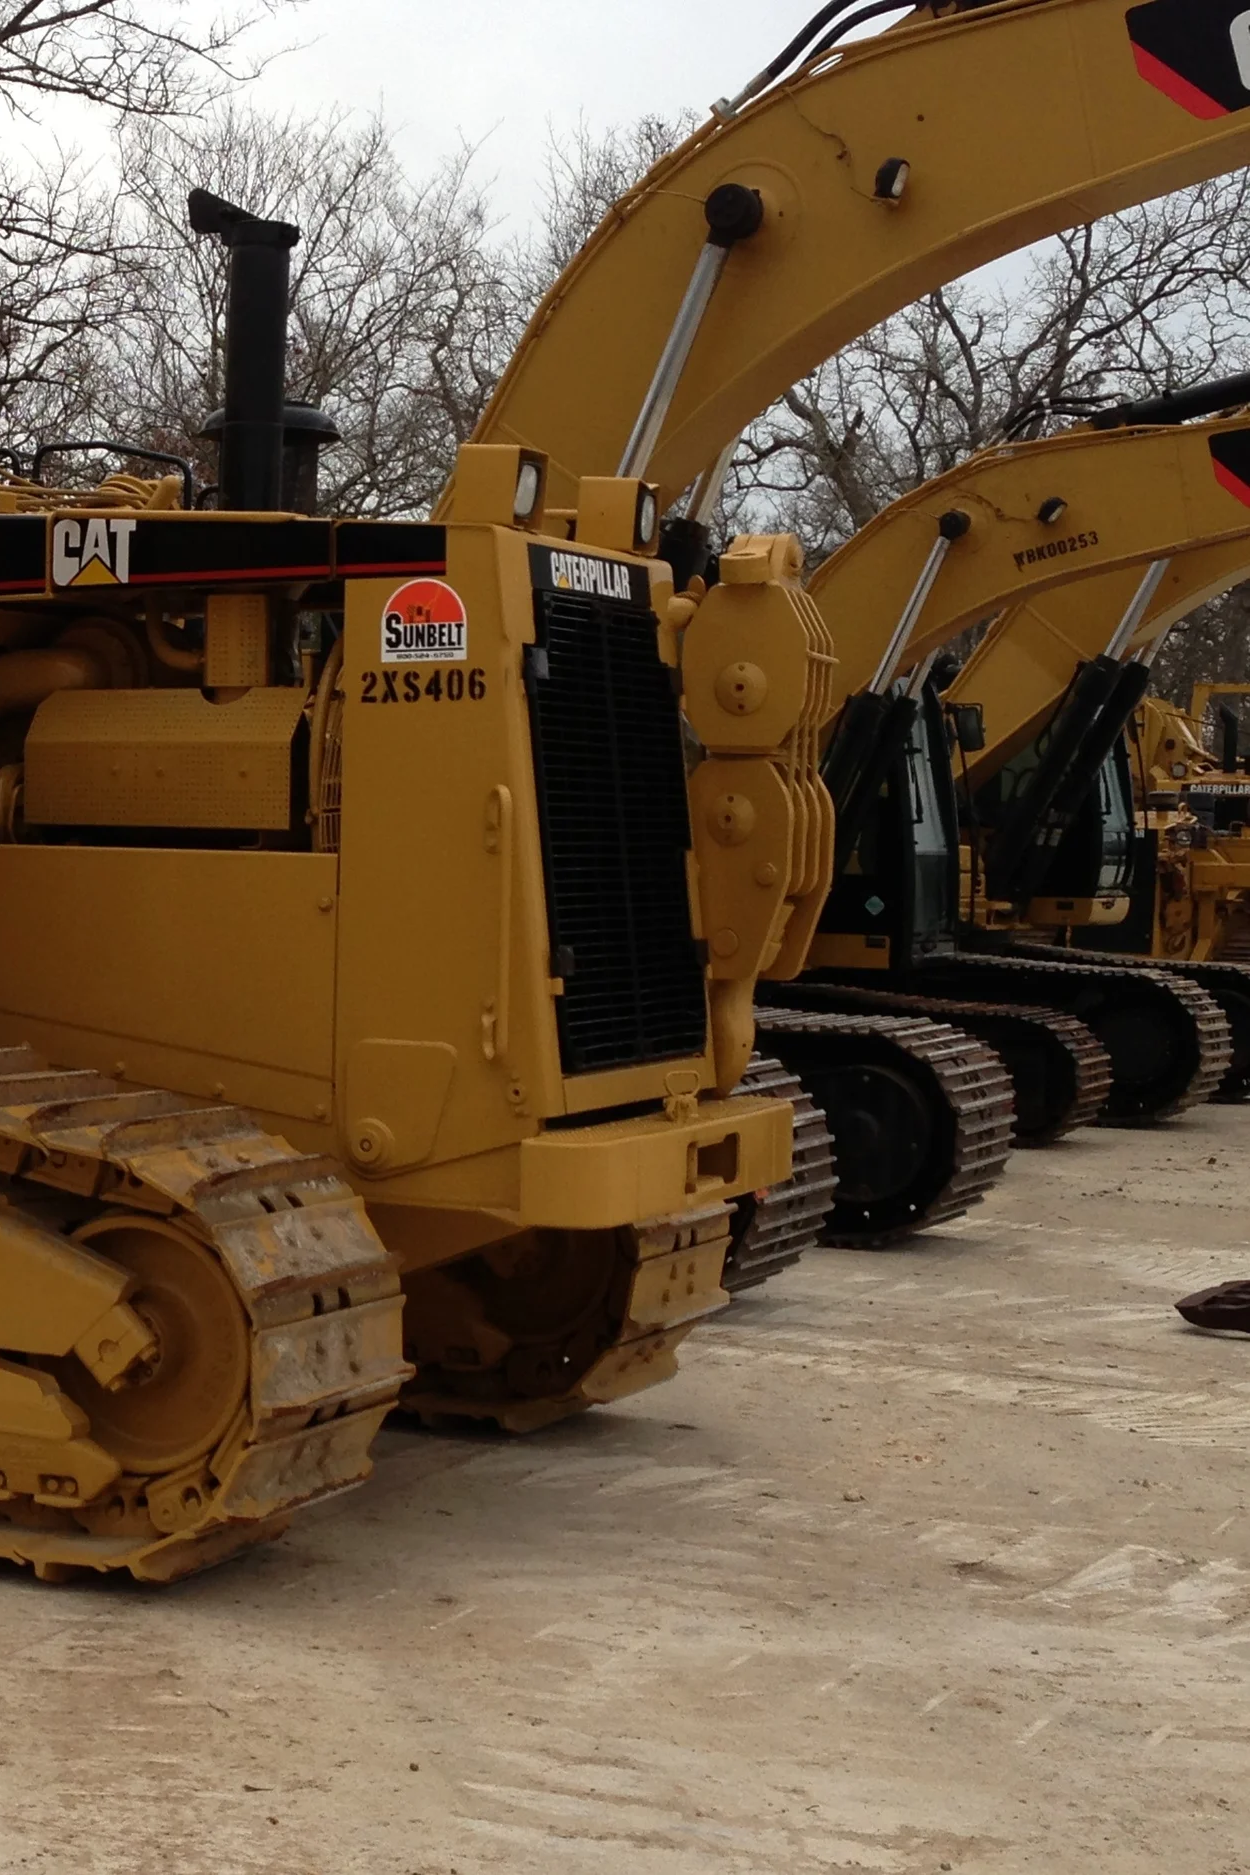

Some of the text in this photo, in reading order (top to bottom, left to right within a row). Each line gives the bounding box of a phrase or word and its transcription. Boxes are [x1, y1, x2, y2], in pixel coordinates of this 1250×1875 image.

[53, 518, 137, 586] CAT
[551, 551, 631, 600] CATERPILLAR
[361, 670, 486, 702] 2XS406
[1190, 784, 1250, 794] CATERPILLAR
